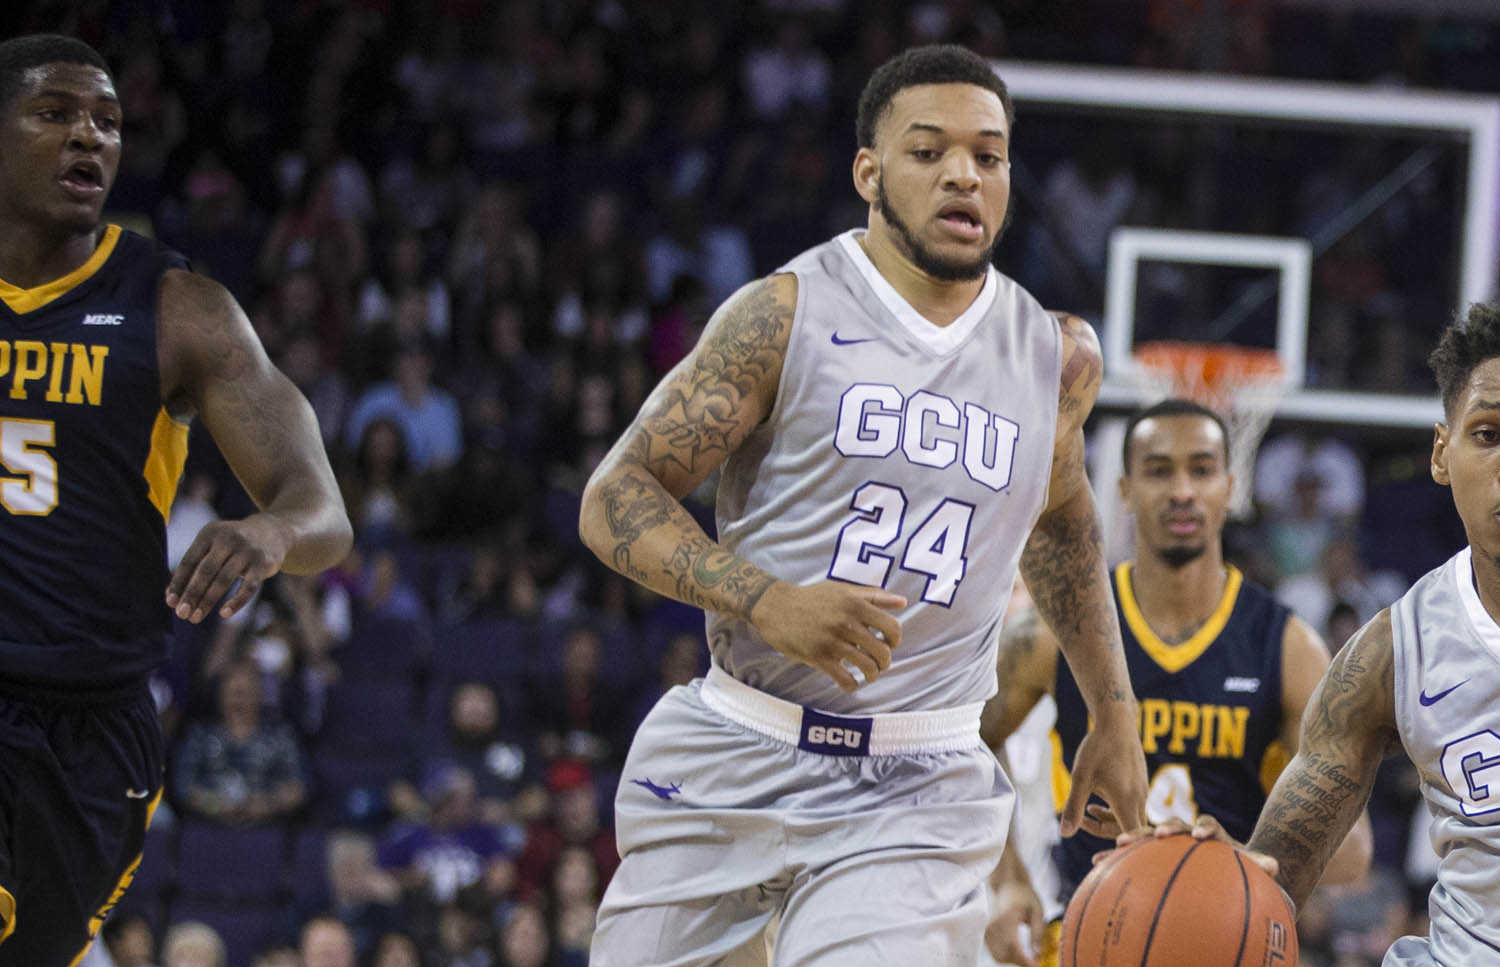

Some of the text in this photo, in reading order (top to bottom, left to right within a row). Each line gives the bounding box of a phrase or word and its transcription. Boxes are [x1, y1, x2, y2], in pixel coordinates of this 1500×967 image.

[82, 314, 125, 326] MEAC
[833, 383, 1020, 492] GCU
[827, 480, 976, 609] 24
[808, 726, 862, 748] GCU
[1138, 699, 1250, 758] PPIN
[1146, 764, 1199, 826] 4
